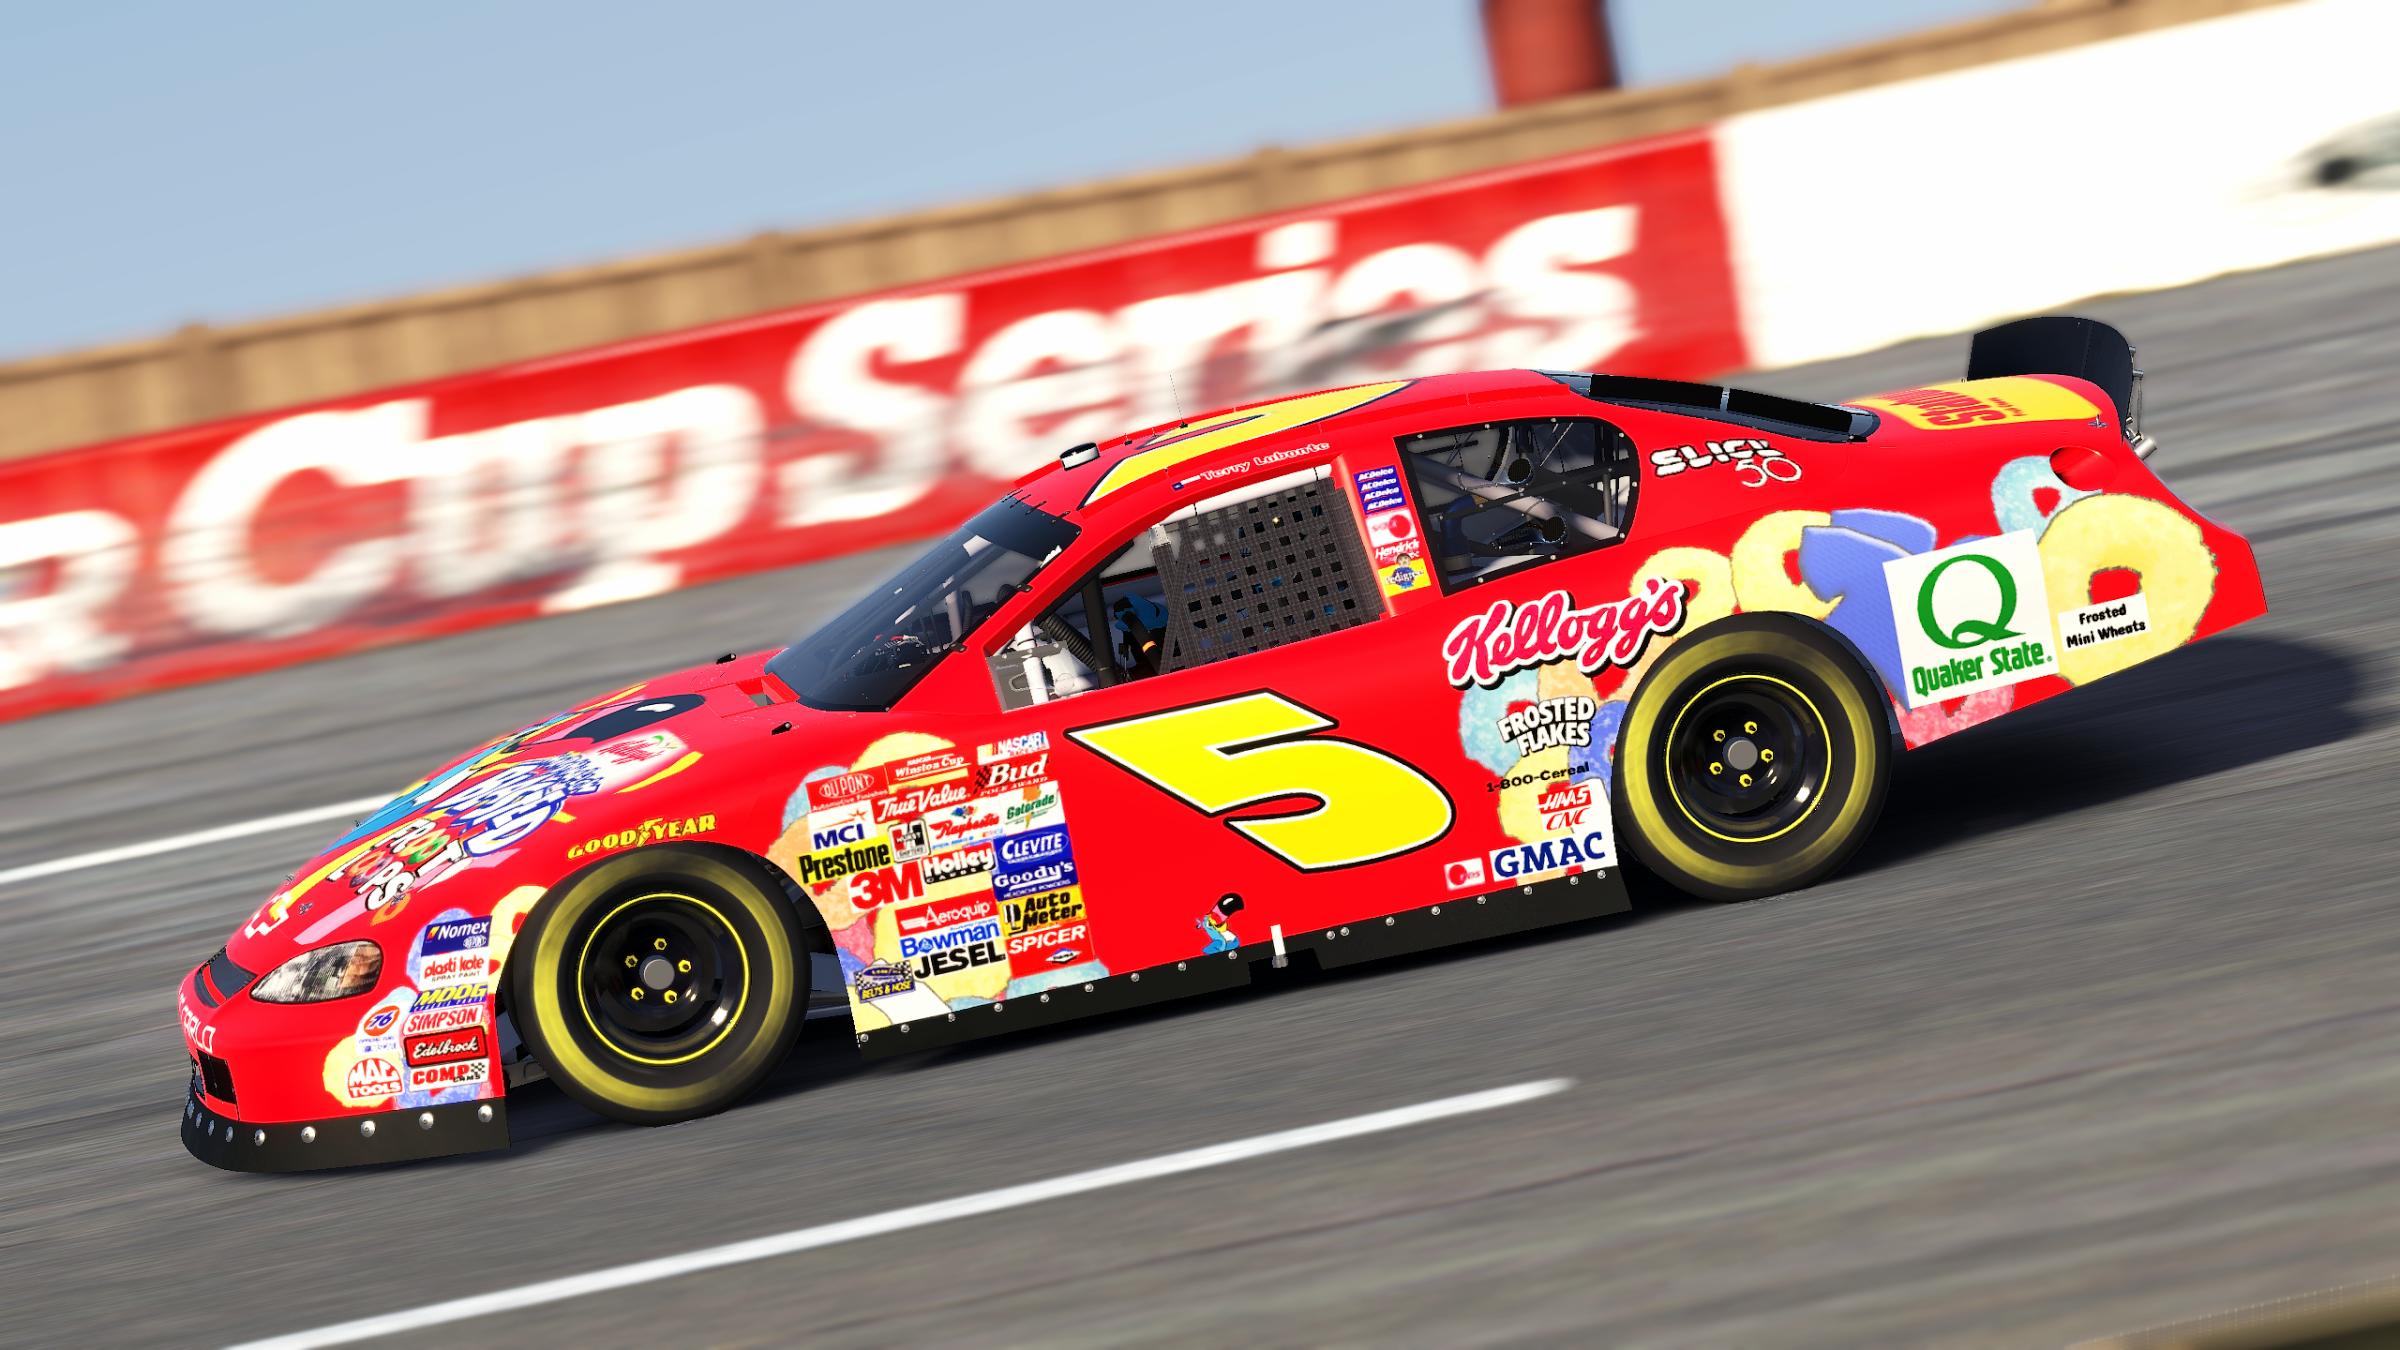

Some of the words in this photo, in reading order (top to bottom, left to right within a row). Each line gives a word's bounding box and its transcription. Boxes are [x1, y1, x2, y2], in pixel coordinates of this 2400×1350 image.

[160, 397, 765, 638] Cup
[782, 205, 1642, 528] Series
[1200, 461, 1251, 480] Terry
[1254, 442, 1330, 466] Labonte
[1735, 457, 1803, 488] 50
[1375, 539, 1420, 560] Hendrick
[1916, 553, 2026, 650] Q
[2078, 603, 2128, 627] Frosted
[1443, 577, 1686, 690] Kellogg's
[2066, 632, 2096, 649] Mini
[2097, 619, 2147, 640] Wheats
[1912, 655, 1984, 698] Quaker
[1990, 641, 2046, 676] State
[1496, 696, 1597, 743] FROSTED
[1516, 721, 1592, 758] FLAKES
[895, 761, 940, 778] Winston
[941, 755, 965, 770] Cup
[987, 753, 1049, 787] Bud
[1063, 687, 1457, 874] 5
[1486, 762, 1590, 794] 1-800-Cereal
[1006, 793, 1056, 819] Gatorade
[1542, 788, 1591, 812] HAAS
[1546, 811, 1588, 832] CNC
[813, 824, 866, 851] MCI
[1002, 832, 1063, 861] CLEVITE
[799, 841, 892, 885] Prestone
[924, 847, 996, 876] Holley
[1494, 831, 1606, 879] GMAC
[850, 867, 926, 910] 3M
[994, 861, 1075, 891] Goody's
[923, 901, 991, 927] Aeroquip
[1024, 891, 1071, 913] Auto
[438, 920, 490, 940] Nomex
[1022, 903, 1083, 931] Meter
[900, 921, 1001, 959] Bowman
[1009, 925, 1086, 955] SPICER
[424, 954, 457, 979] plasti
[459, 953, 484, 970] kote
[914, 940, 1006, 979] JESEL
[414, 983, 488, 1006] MOOG
[862, 986, 885, 1001] BELTS
[369, 1010, 394, 1028] 76
[407, 1007, 478, 1032] SIMPSON
[413, 1036, 478, 1058] Edelbrock
[350, 1058, 396, 1087] MAC
[412, 1063, 470, 1085] COMP
[350, 1081, 401, 1097] TOOLS
